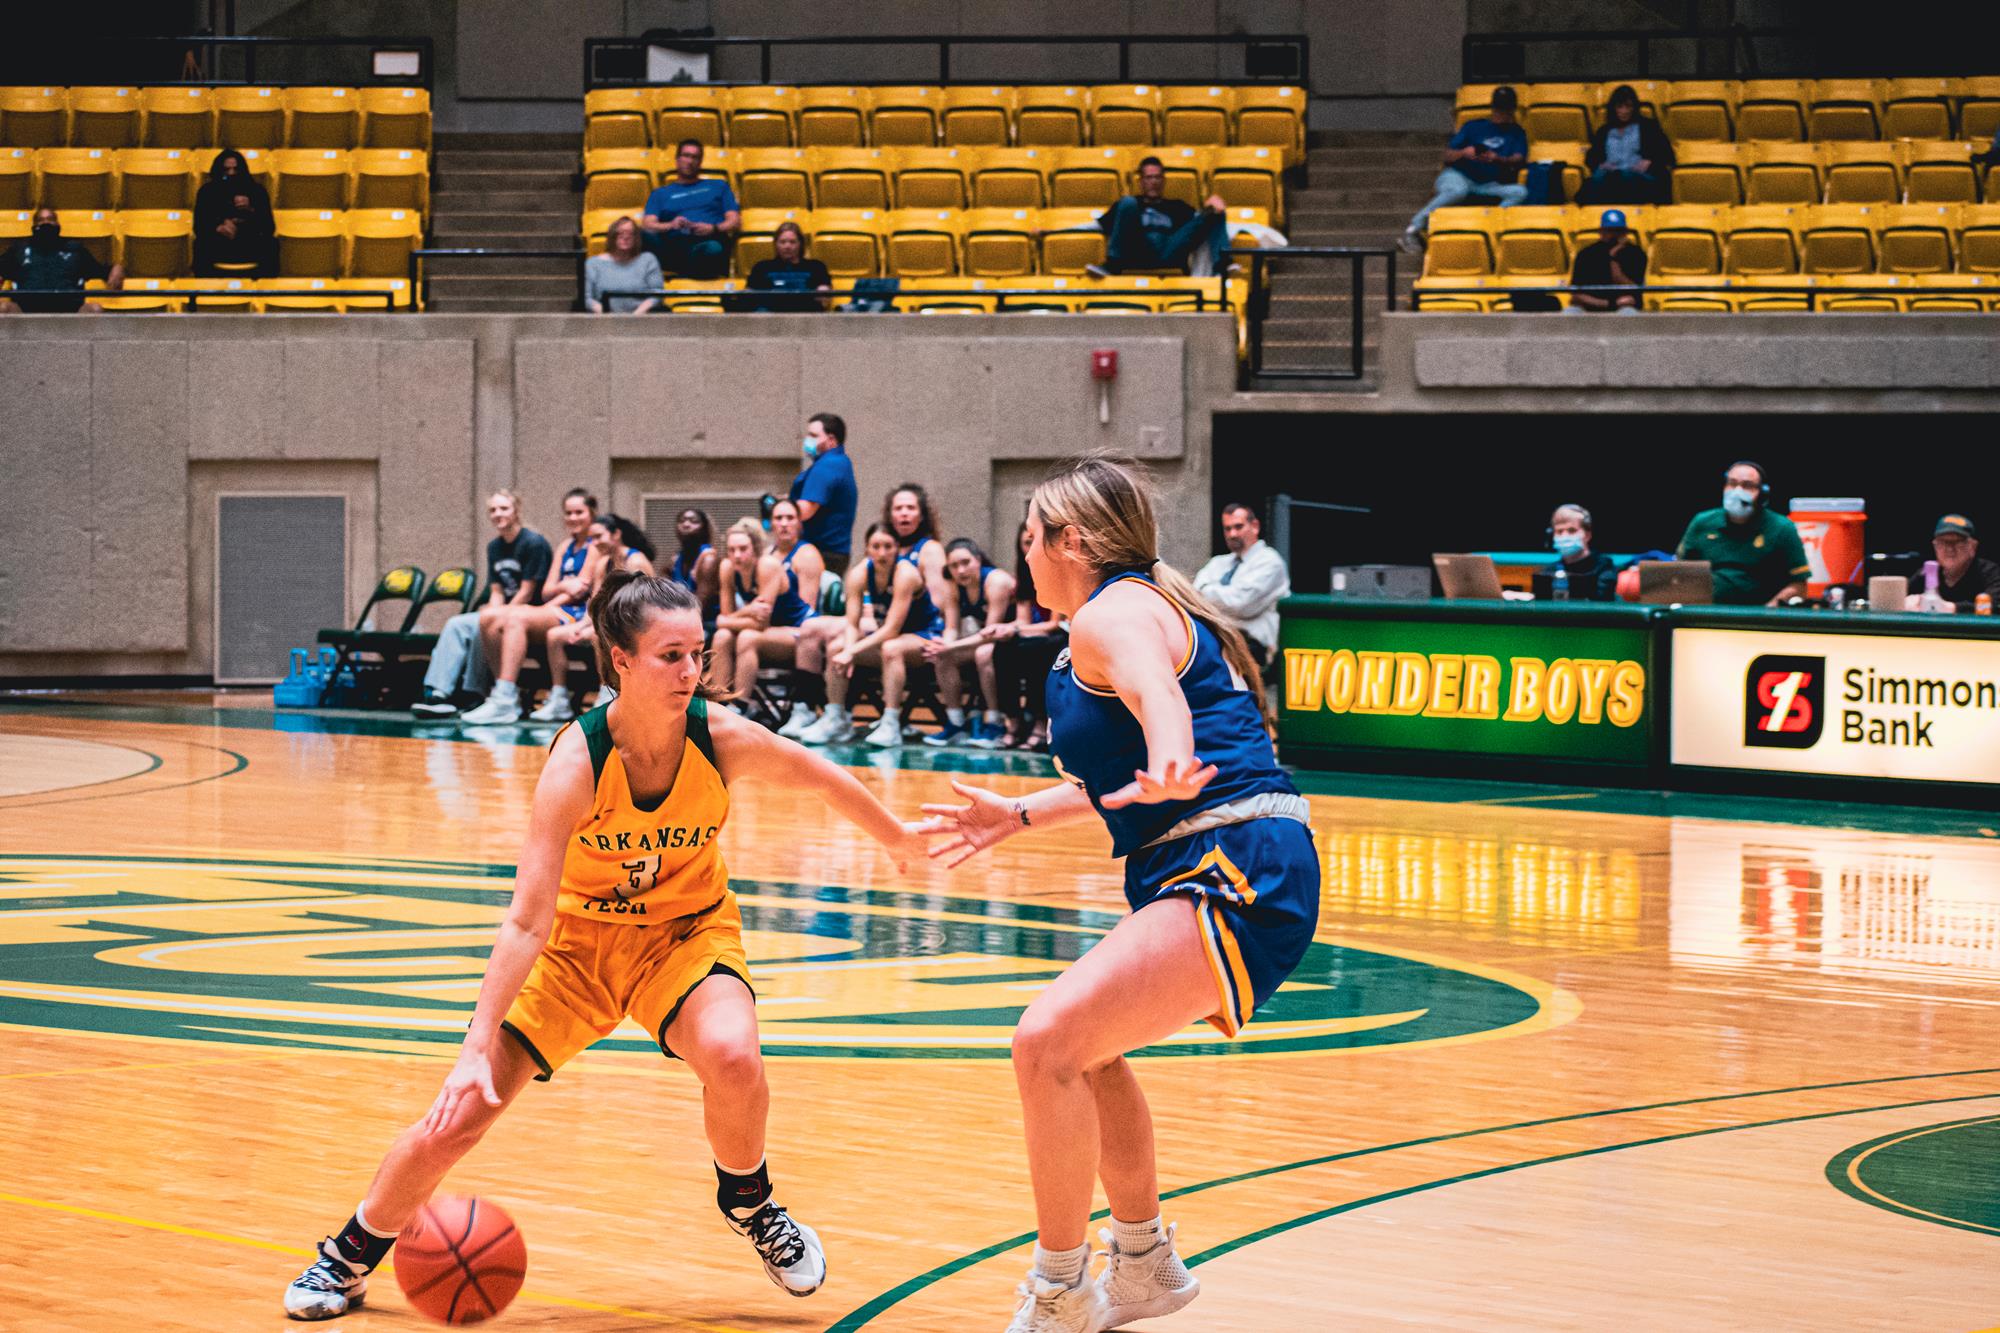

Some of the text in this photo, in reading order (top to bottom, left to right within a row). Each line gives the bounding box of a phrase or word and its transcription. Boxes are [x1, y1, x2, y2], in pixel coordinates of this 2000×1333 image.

[1284, 648, 1645, 727] WONDER BOYS
[1843, 667, 2000, 709] Simmon
[1842, 709, 1934, 747] Bank
